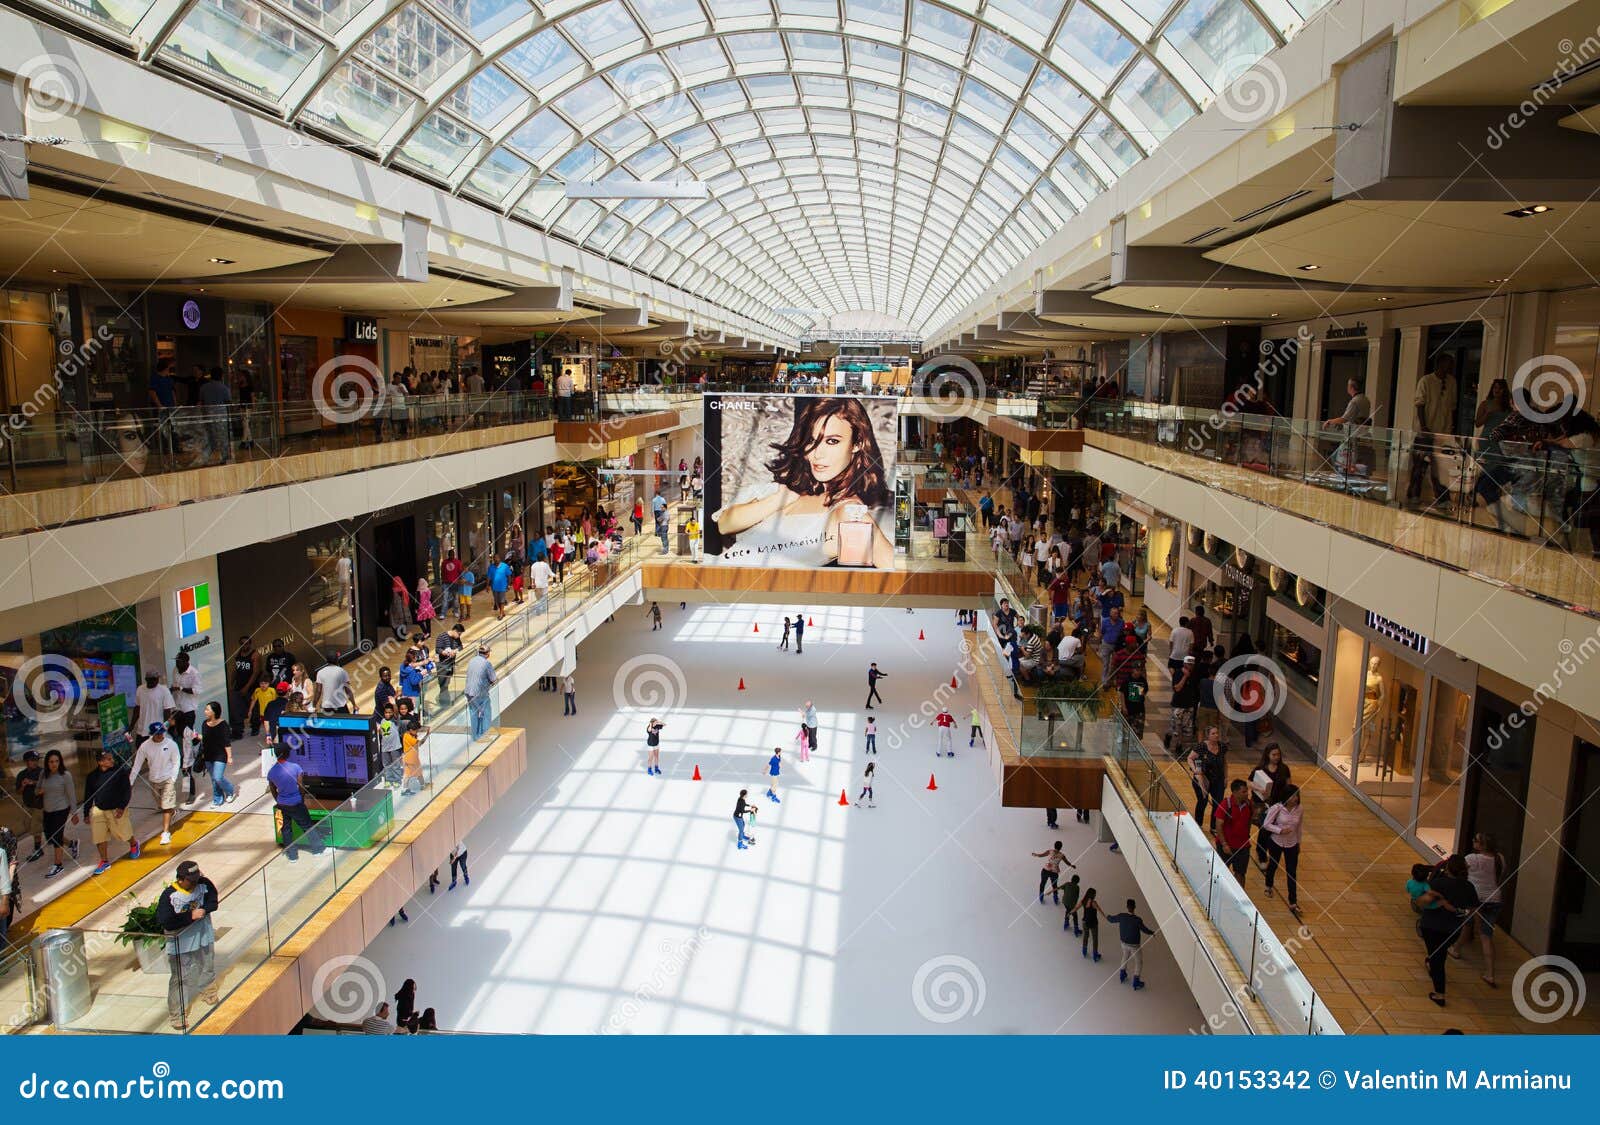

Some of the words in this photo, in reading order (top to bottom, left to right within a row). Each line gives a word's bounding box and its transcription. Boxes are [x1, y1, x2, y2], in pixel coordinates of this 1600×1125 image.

[355, 321, 378, 340] Lids
[709, 401, 758, 411] CHANEL
[180, 635, 211, 654] Microsoft
